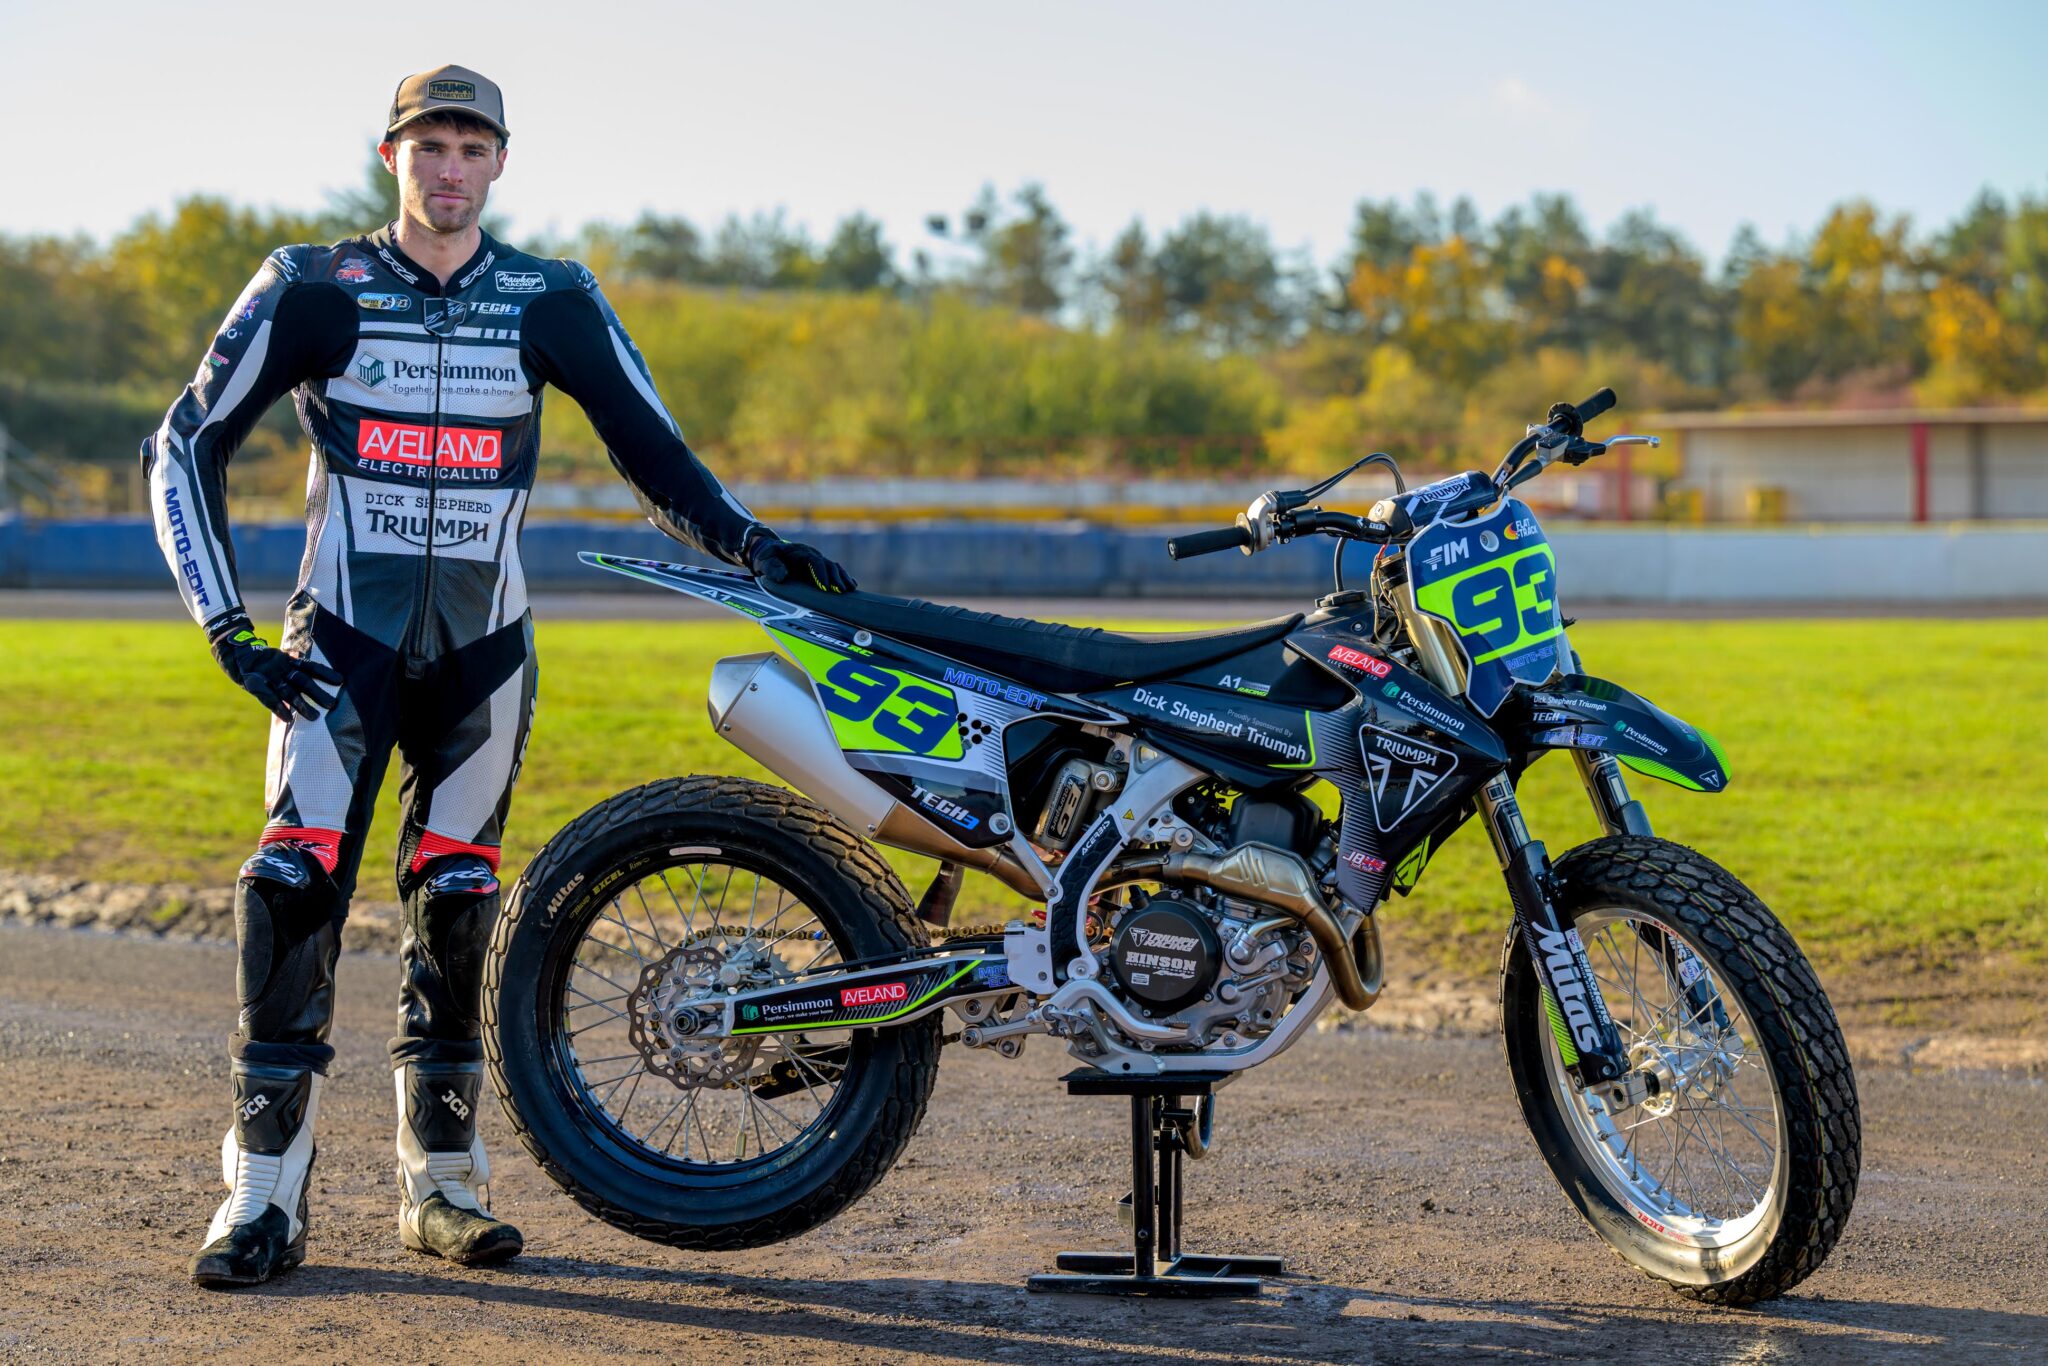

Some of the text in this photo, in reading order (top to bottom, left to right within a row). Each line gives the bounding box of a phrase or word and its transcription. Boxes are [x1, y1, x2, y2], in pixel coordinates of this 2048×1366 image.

[430, 82, 473, 93] TRIUMPH
[498, 273, 542, 286] Hawkeye
[394, 360, 517, 382] Persimmon
[393, 385, 435, 397] Together,
[457, 385, 480, 394] make
[491, 386, 516, 396] home.
[362, 427, 498, 462] AVELAND
[357, 458, 499, 480] ELECTRICAL LTD
[365, 493, 492, 514] DICK SHEPHERD
[1418, 481, 1471, 503] TRIUMPH
[366, 509, 489, 545] TRIUMPH
[1515, 518, 1530, 532] FLAT
[1519, 525, 1538, 538] TRACK
[165, 486, 210, 607] MOTO-EDIT
[1424, 537, 1470, 571] FIM
[701, 589, 732, 601] A1
[1451, 551, 1556, 645] 93
[1327, 659, 1364, 676] ELECTRICAL
[1330, 648, 1389, 676] AVELAND
[943, 667, 1047, 710] MOTO-EDIT
[1218, 674, 1242, 689] A1
[1237, 687, 1268, 697] RACING
[816, 659, 959, 755] 93
[1400, 691, 1465, 731] Persimmon
[1533, 694, 1607, 711] Dick Shepherd Triumph
[1133, 687, 1307, 760] Dick Shepherd Triumph
[1227, 709, 1293, 738] Proudly Sponsored By
[1376, 736, 1438, 766] TRIUMPH
[1625, 726, 1668, 754] Persimmon
[1050, 778, 1074, 832] Motorsport
[1081, 820, 1110, 856] ACERBIS
[1342, 851, 1365, 865] JB
[592, 869, 625, 895] EXCEL
[546, 872, 585, 918] Mitas
[1148, 932, 1199, 946] TRIUMPH
[1653, 920, 1680, 938] EXCEL
[1126, 951, 1196, 971] HINSON
[844, 985, 905, 1004] AVELAND
[1531, 921, 1601, 1053] Mitas
[1579, 953, 1611, 1025] Silkolene
[762, 998, 833, 1015] Persimmon
[240, 1094, 270, 1121] JCR
[441, 1089, 469, 1120] JCR
[1637, 1211, 1665, 1233] EXCEL
